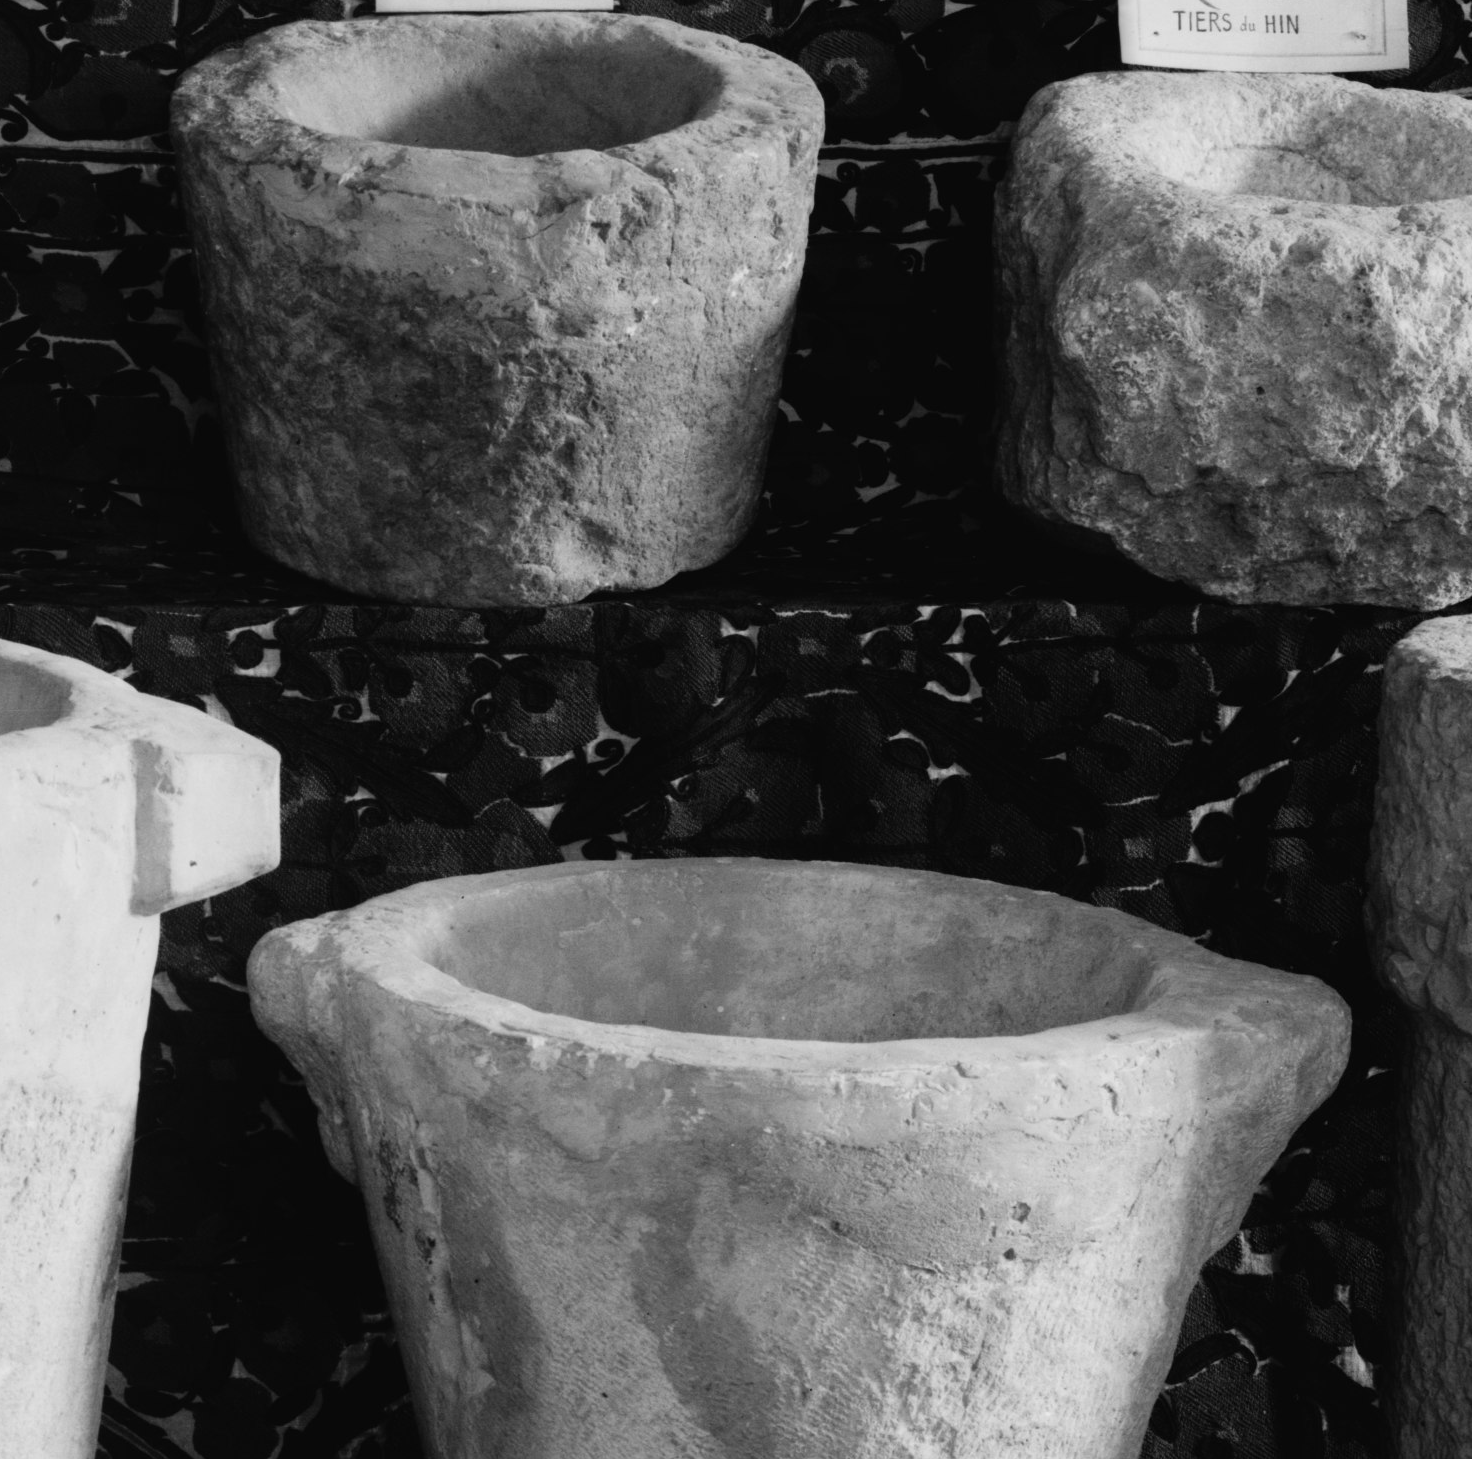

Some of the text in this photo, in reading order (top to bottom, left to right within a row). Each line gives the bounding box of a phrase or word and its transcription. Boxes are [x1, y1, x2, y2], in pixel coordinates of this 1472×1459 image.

[1174, 11, 1299, 34] TIERS du HIN
